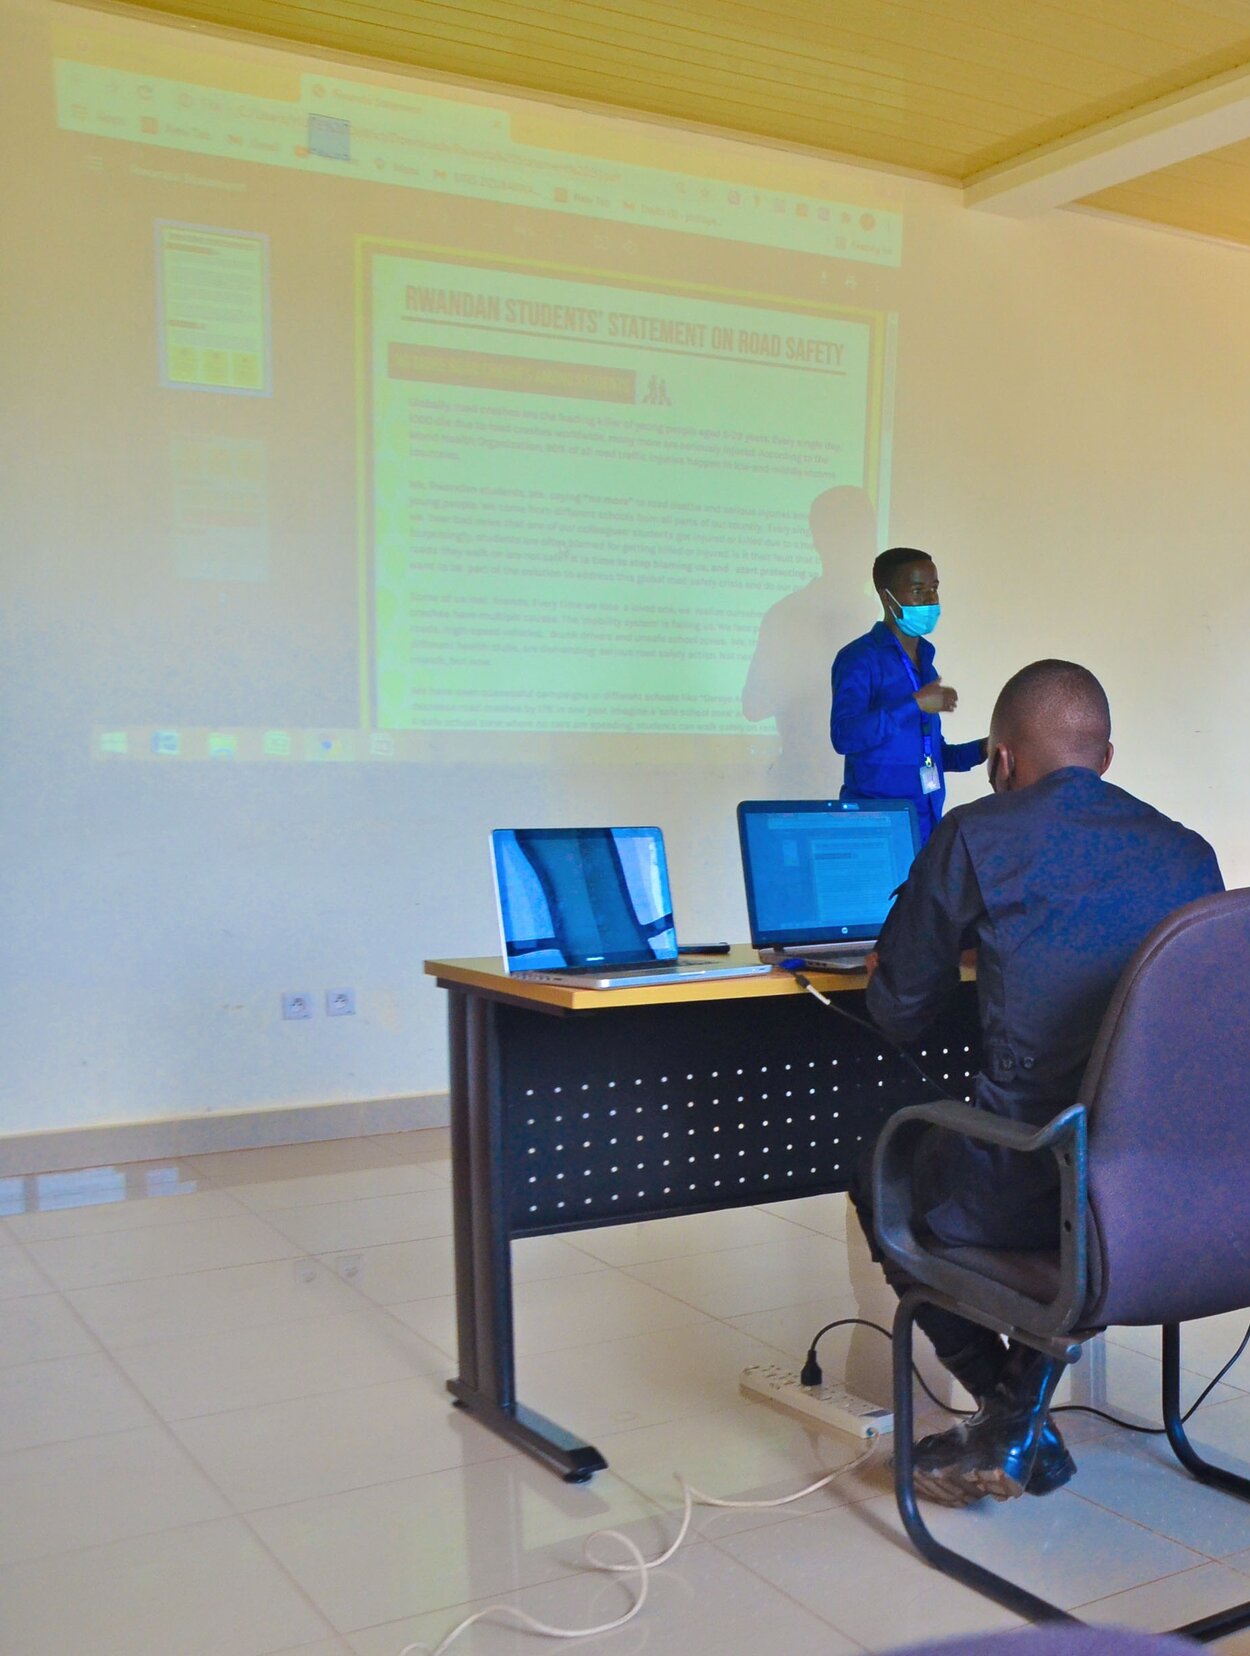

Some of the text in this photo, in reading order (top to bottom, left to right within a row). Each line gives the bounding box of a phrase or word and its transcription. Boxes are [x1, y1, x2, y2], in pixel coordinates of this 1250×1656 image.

[404, 284, 844, 366] RWANDAN STUDENTS' STATEMENT ON ROAD SAFETY
